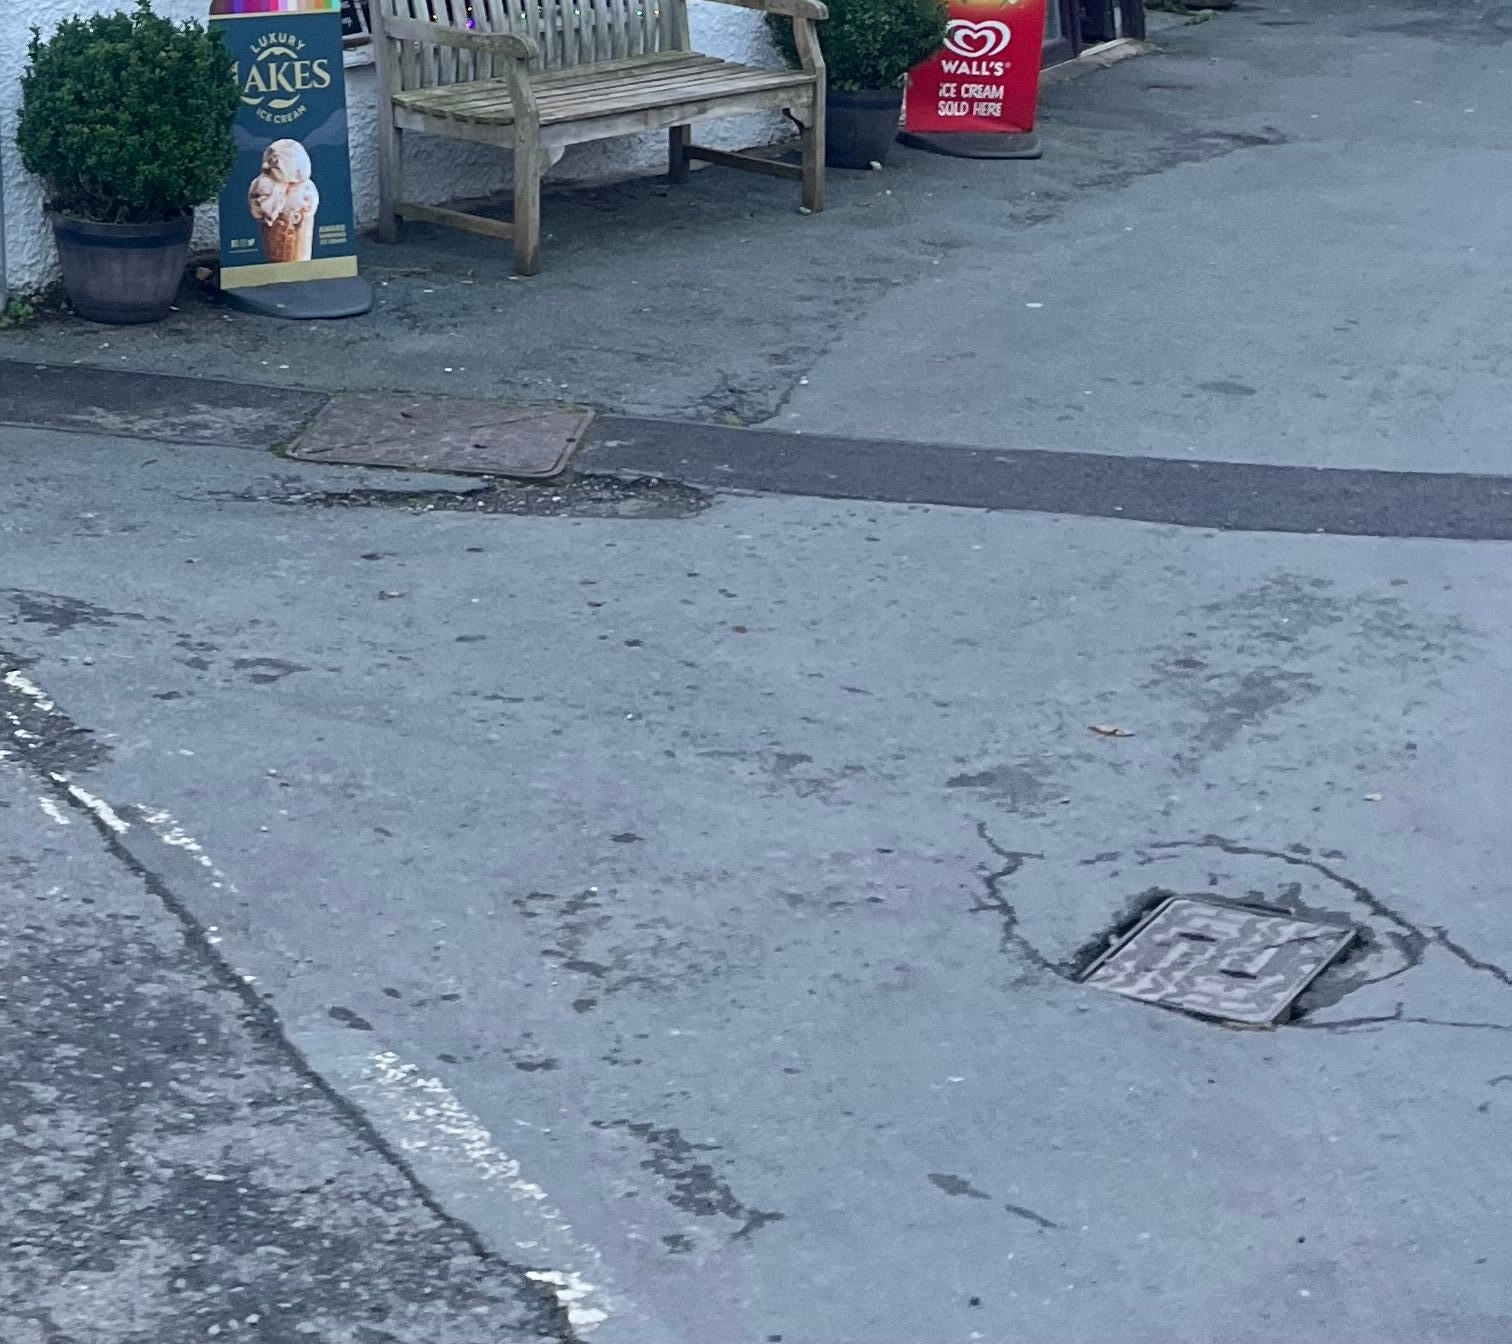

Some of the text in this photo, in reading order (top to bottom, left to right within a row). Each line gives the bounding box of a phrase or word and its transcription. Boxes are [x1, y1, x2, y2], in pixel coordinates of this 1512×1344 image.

[249, 32, 306, 53] LUXURY
[941, 60, 1004, 76] WALL'S
[938, 82, 1005, 99] ICE CREAM
[256, 104, 307, 123] ICE CREAM
[937, 100, 1003, 117] SOLD HERE
